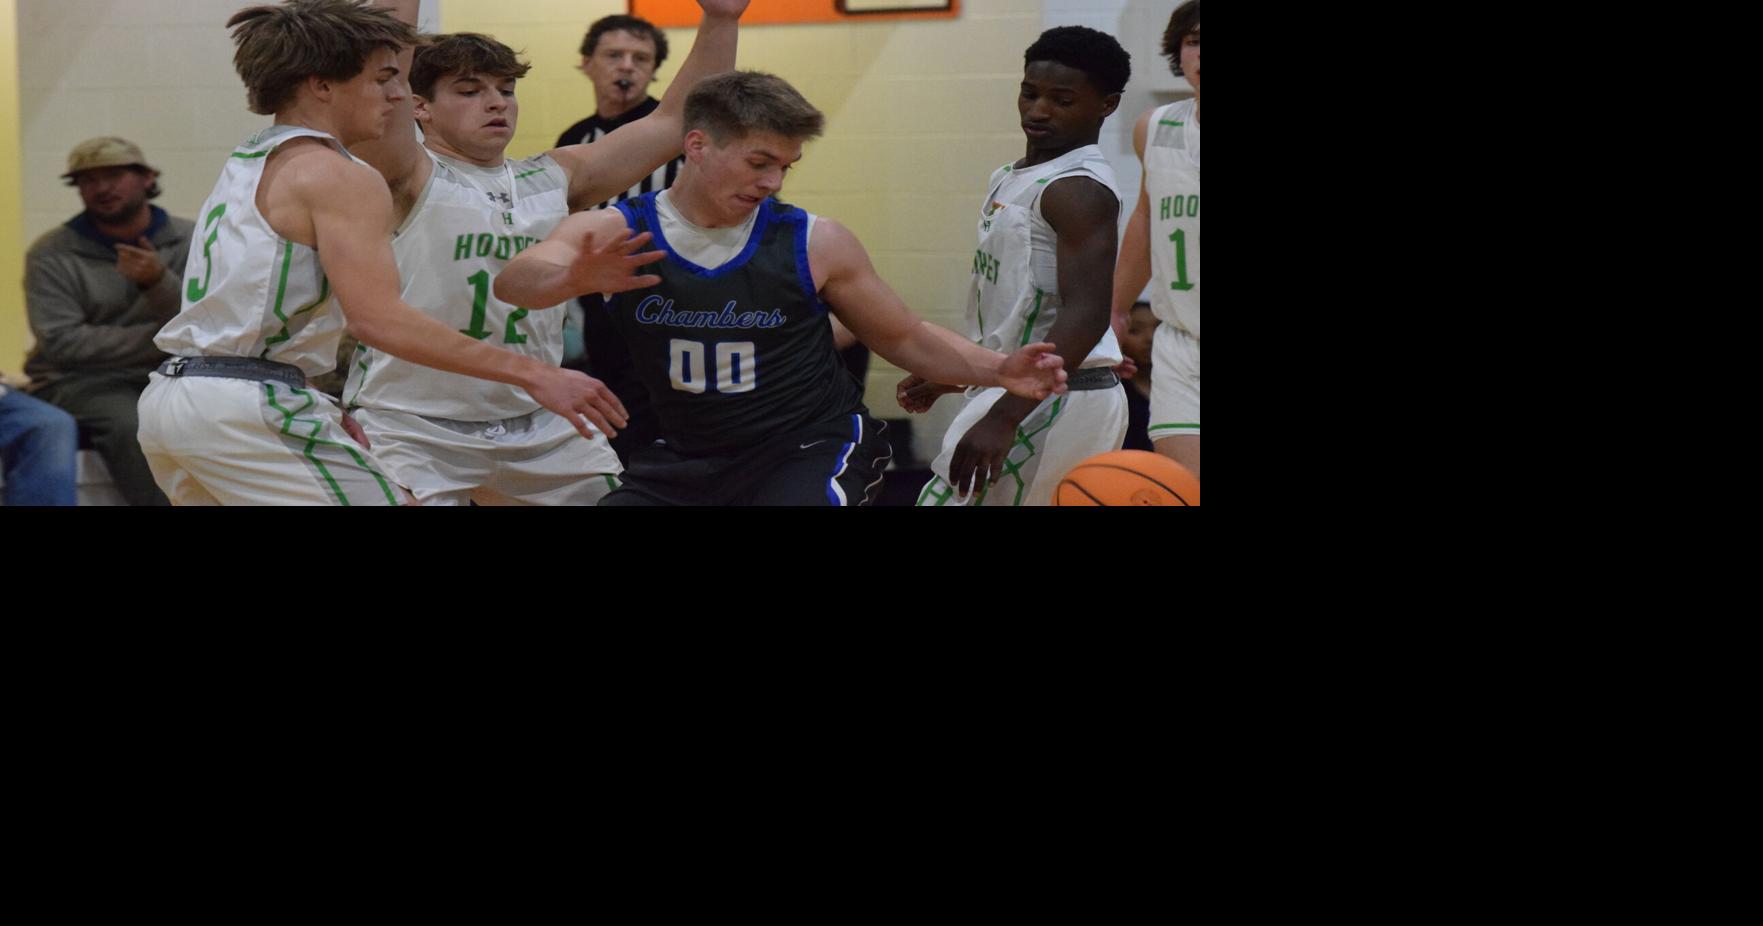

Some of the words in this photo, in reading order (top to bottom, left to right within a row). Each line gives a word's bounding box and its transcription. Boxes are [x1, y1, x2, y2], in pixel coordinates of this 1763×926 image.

[453, 233, 542, 261] HOOP
[502, 212, 514, 225] H
[187, 203, 226, 303] 3
[1168, 228, 1195, 291] 1
[458, 269, 528, 344] 12
[635, 294, 787, 328] Chambers
[668, 337, 756, 394] 00
